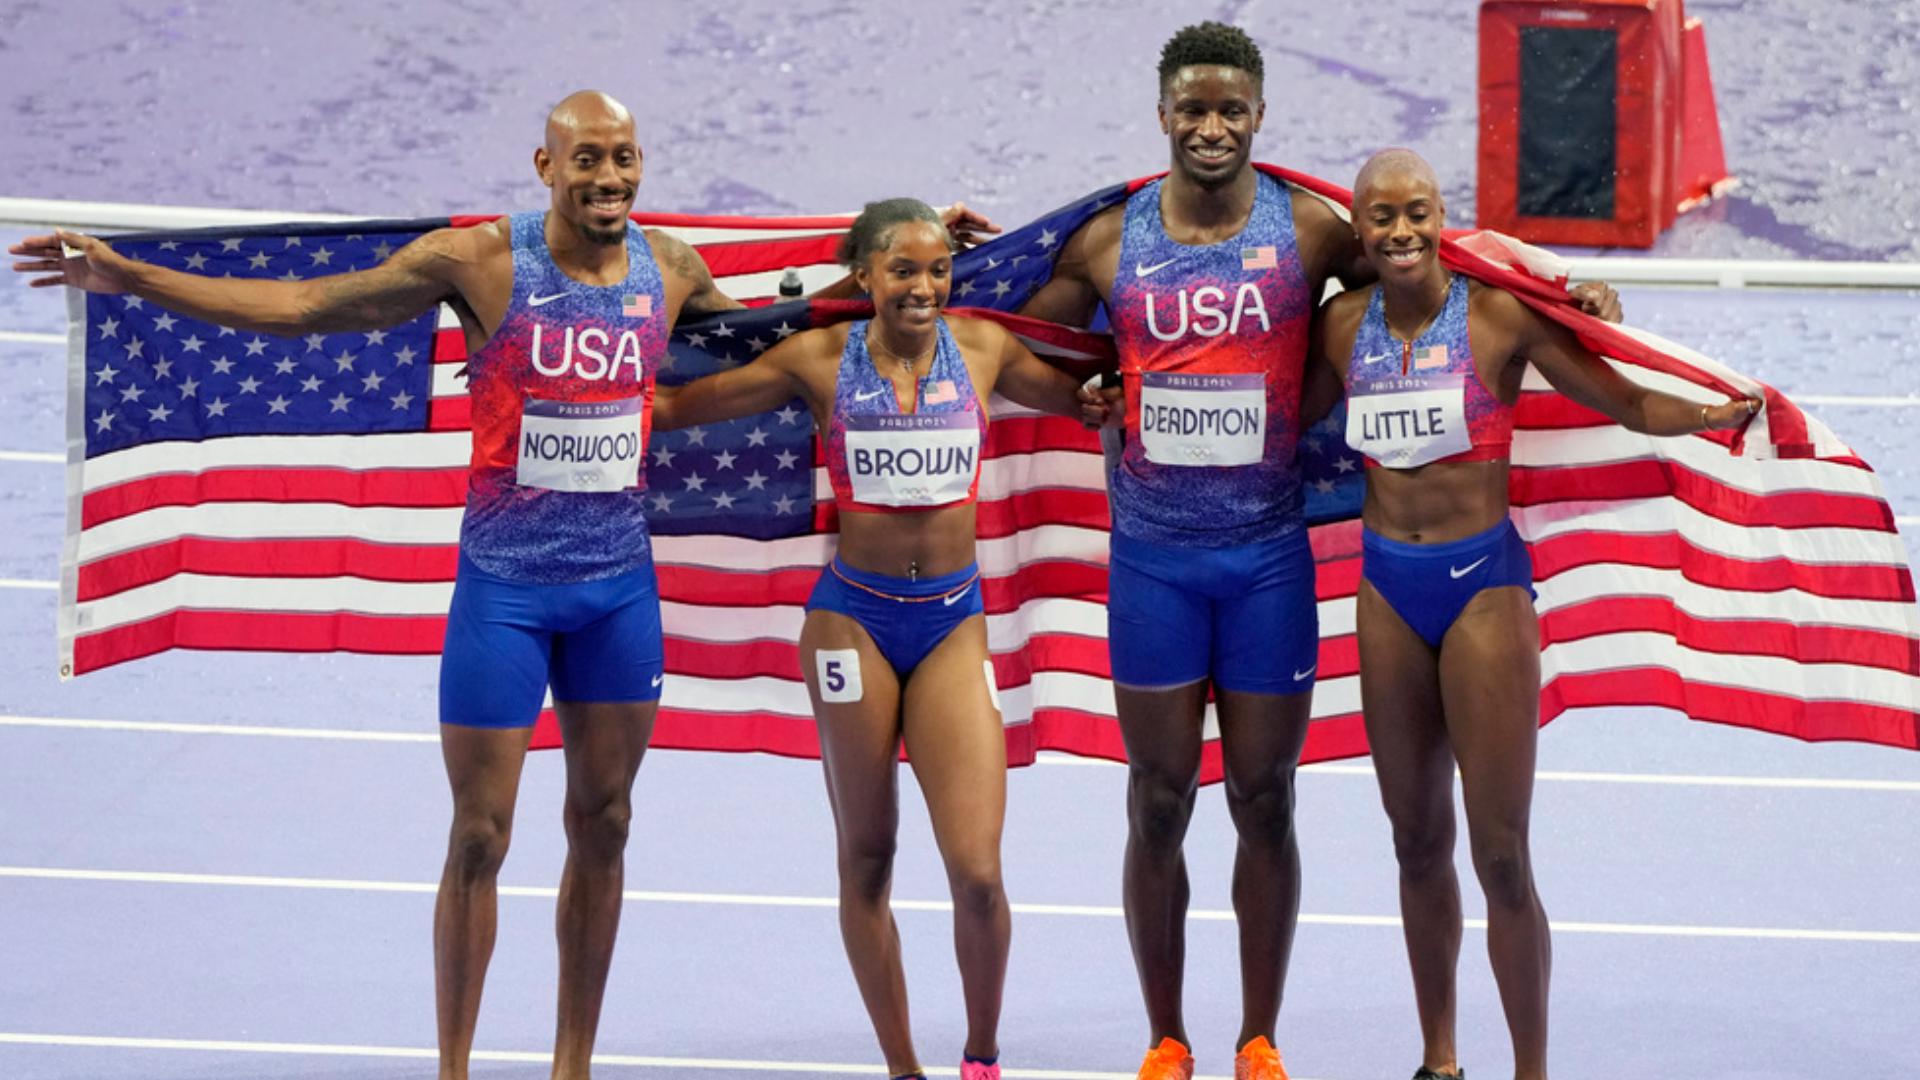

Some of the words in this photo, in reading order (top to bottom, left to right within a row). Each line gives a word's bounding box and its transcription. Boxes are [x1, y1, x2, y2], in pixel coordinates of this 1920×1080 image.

[1145, 283, 1270, 341] USA
[532, 324, 642, 381] USA
[1167, 376, 1199, 387] PARIS
[1203, 378, 1232, 387] 2024
[1398, 379, 1429, 388] 2024
[559, 405, 592, 414] PARIS
[879, 418, 914, 427] PARIS
[918, 417, 947, 426] 2024
[1144, 403, 1259, 436] DEADMON
[1362, 407, 1445, 440] LITTLE
[524, 432, 637, 463] NORWOOD
[854, 446, 973, 477] BROWN
[826, 661, 846, 692] 5
